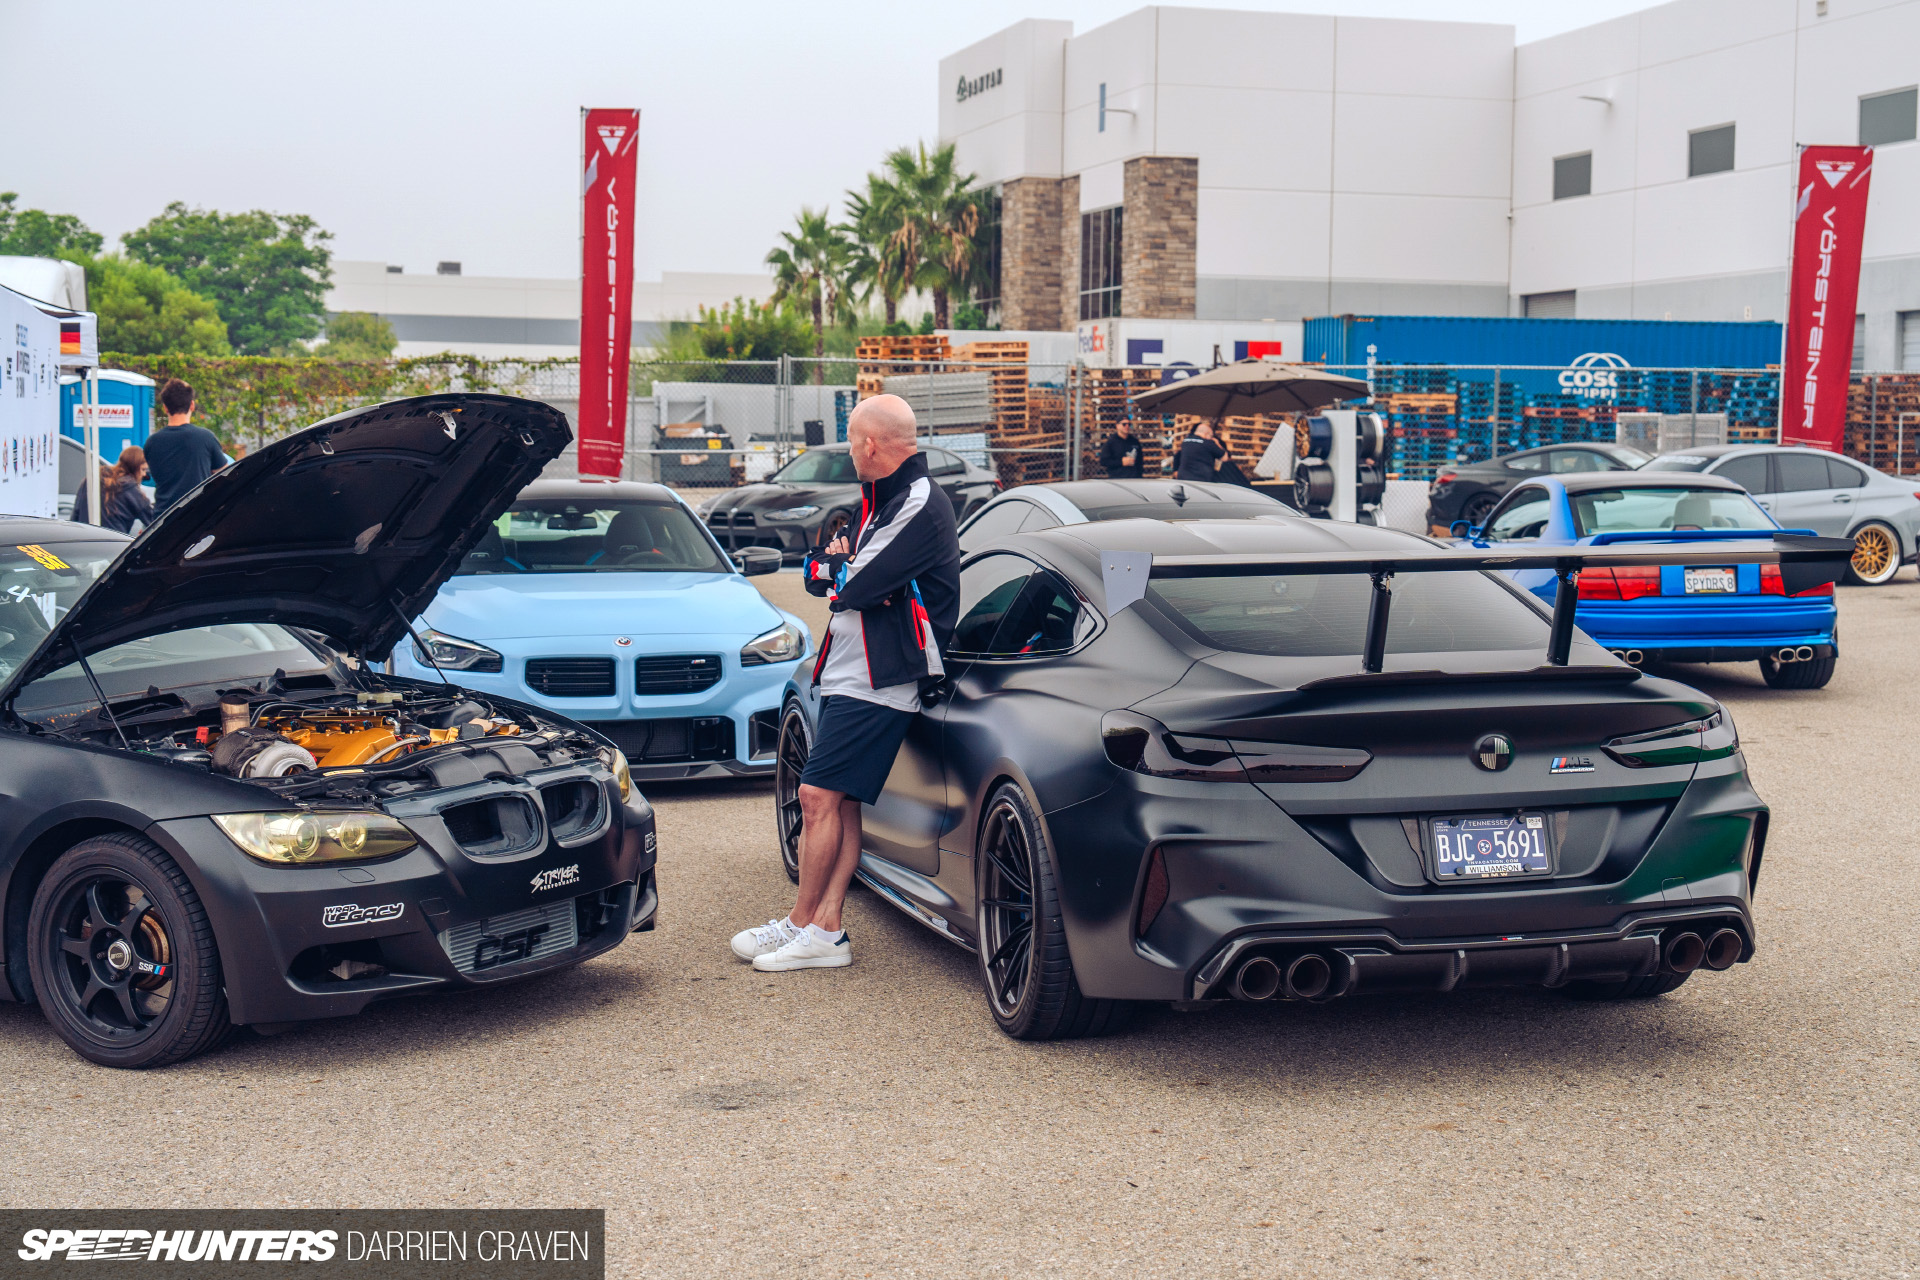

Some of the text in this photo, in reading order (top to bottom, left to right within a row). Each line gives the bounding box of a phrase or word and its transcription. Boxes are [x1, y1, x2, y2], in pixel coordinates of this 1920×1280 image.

[1803, 205, 1837, 429] VÖRSTEINER
[1078, 325, 1105, 352] FedEx
[1558, 370, 1619, 388] COSC
[1727, 577, 1734, 590] 8
[1468, 819, 1509, 827] TENNESSEE
[1437, 829, 1545, 863] BJC 5691
[530, 864, 579, 893] STRYKER
[1469, 865, 1519, 873] WILLIAMSON
[540, 876, 580, 891] PERFORMANCE
[323, 903, 404, 928] LEGACY
[474, 923, 550, 970] CSF
[138, 961, 154, 972] SSR
